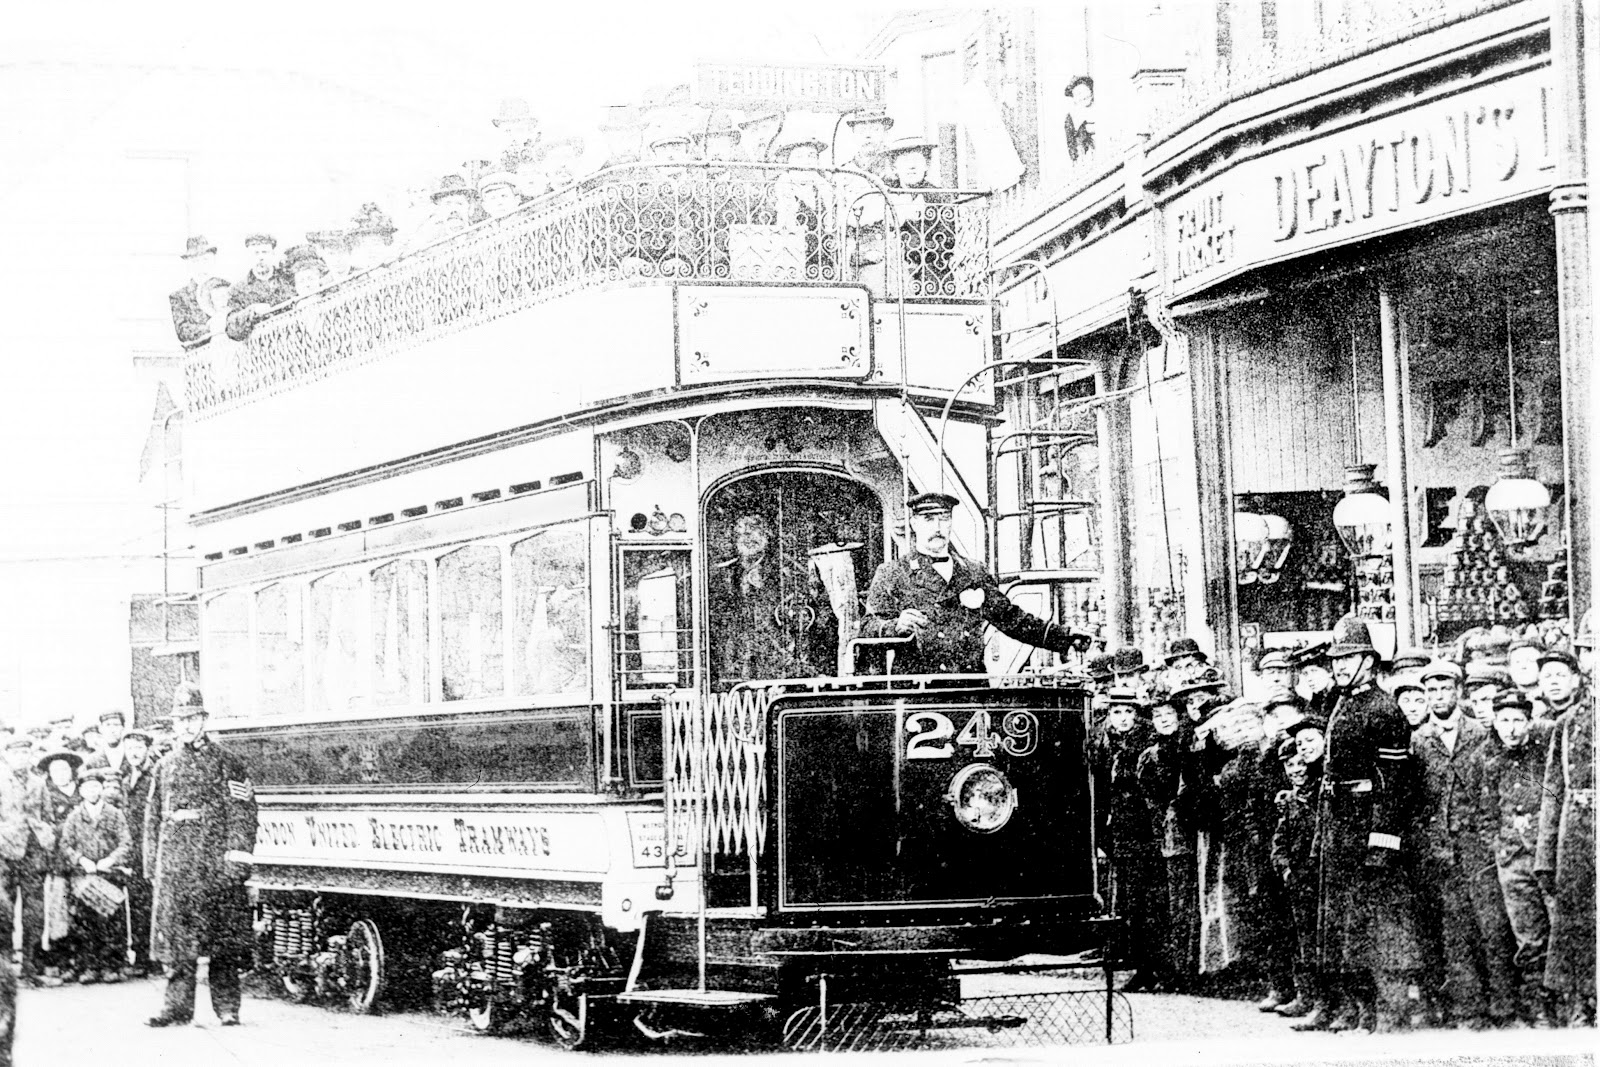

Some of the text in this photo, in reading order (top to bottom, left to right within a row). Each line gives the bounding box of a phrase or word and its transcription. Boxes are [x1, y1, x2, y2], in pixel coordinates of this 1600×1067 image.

[1272, 105, 1519, 243] DEAYTON'S
[905, 710, 1039, 759] 249
[256, 821, 296, 846] ONDON
[367, 817, 443, 852] ELECTRIC
